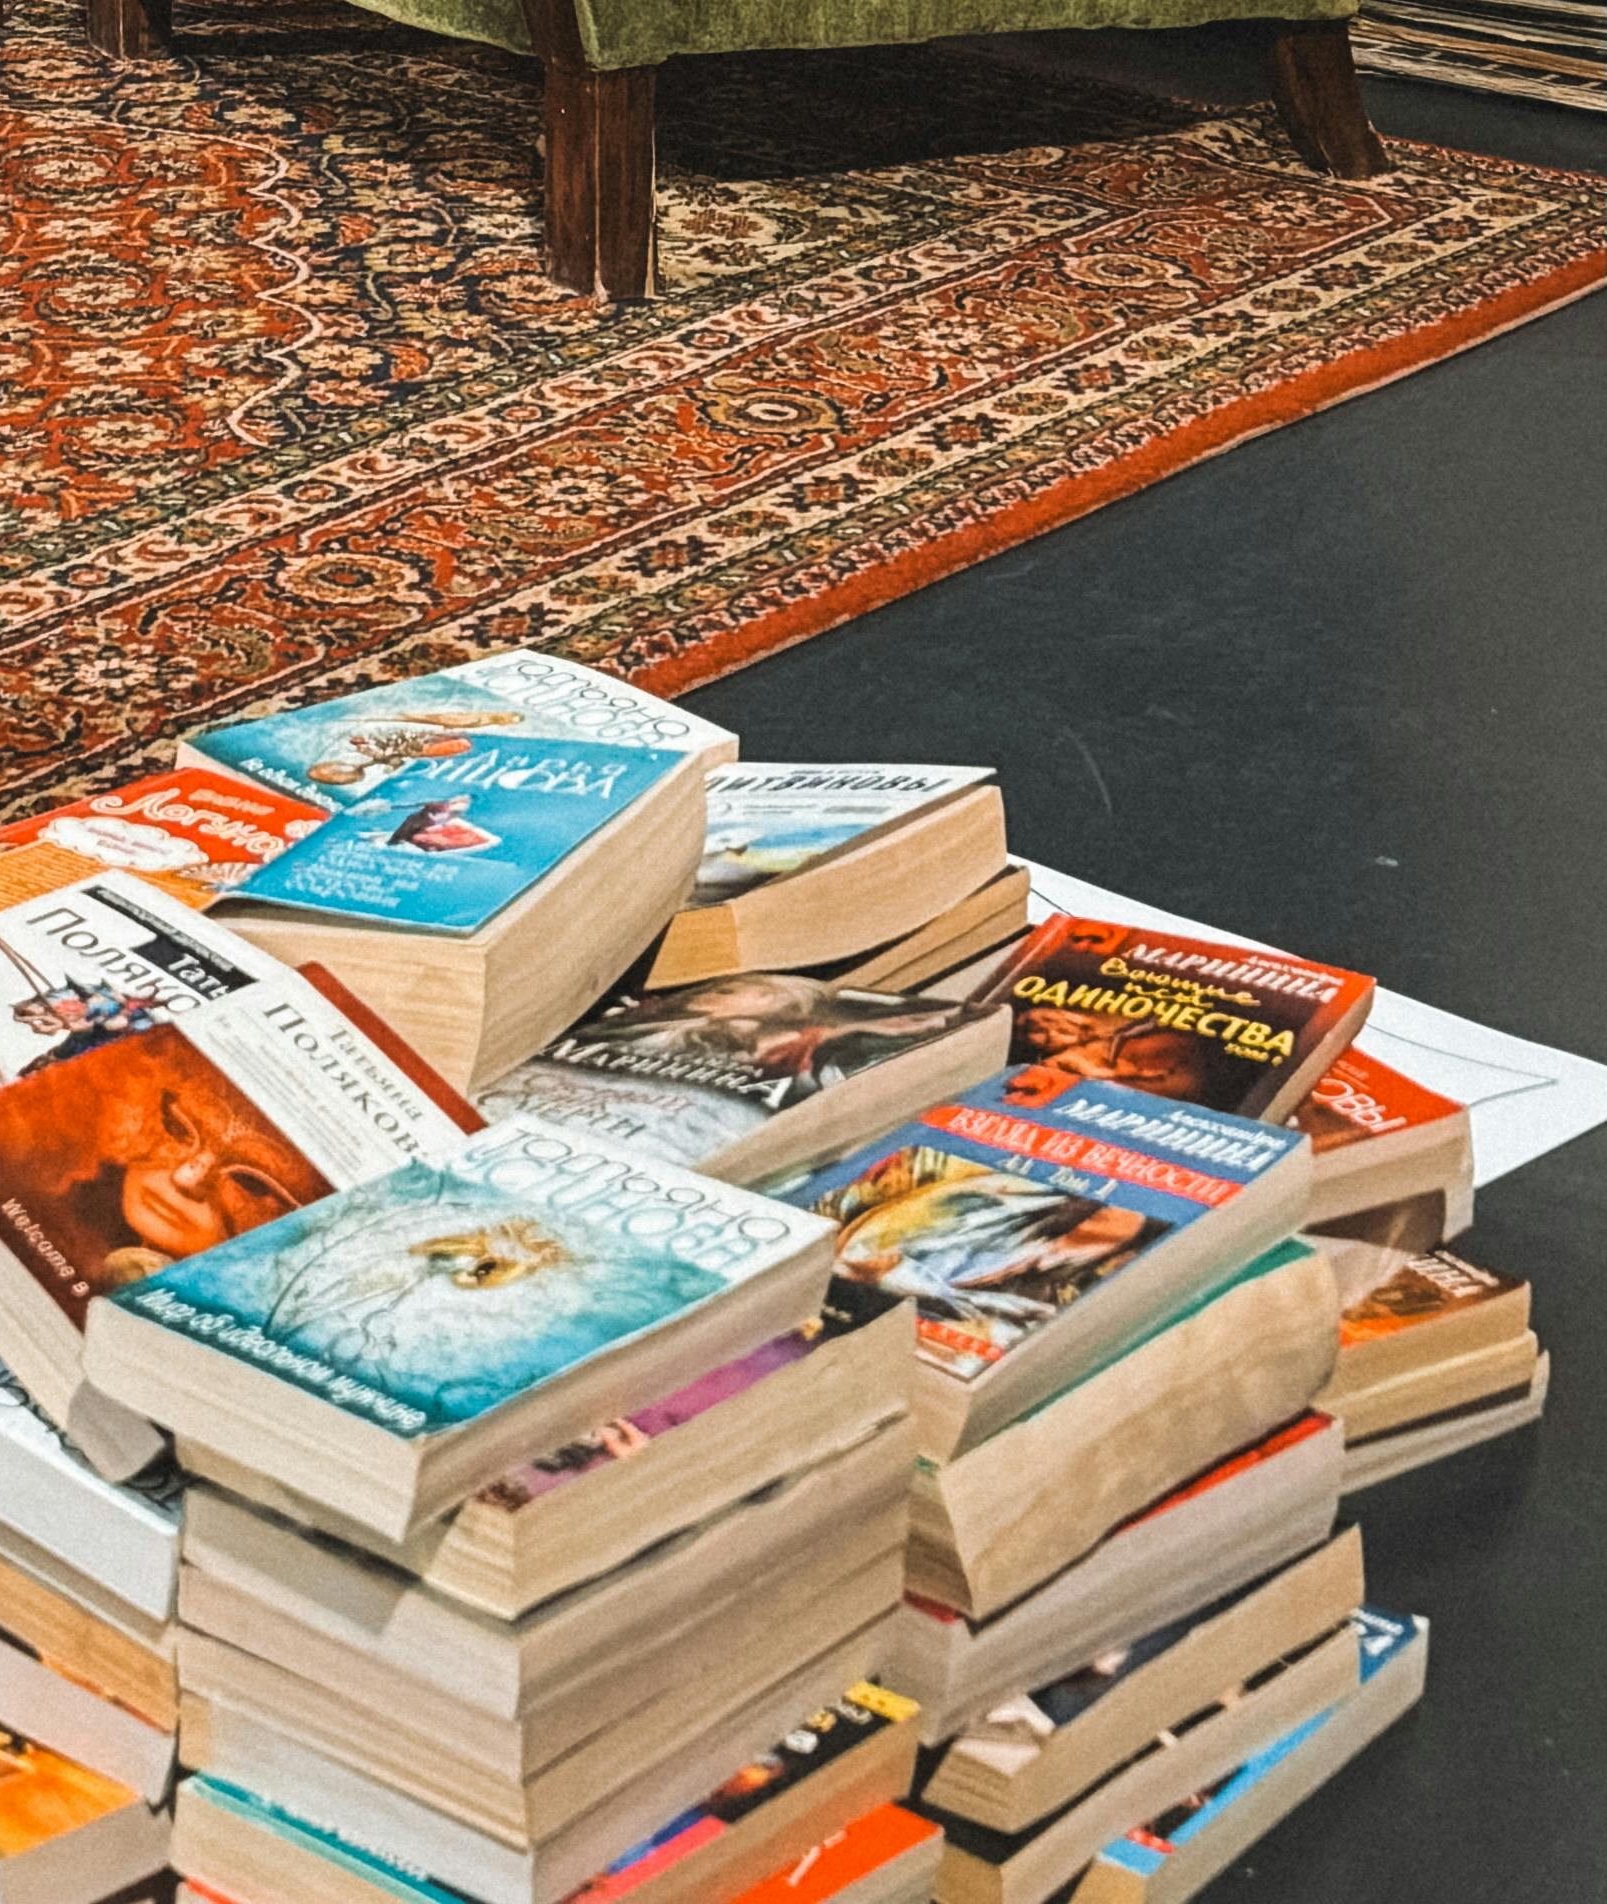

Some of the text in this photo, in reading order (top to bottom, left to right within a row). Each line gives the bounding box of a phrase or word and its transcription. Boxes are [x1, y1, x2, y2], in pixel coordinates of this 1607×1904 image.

[1012, 975, 1295, 1057] ОДИНОЧЕСТВА
[265, 1002, 431, 1160] ПОЛЯКОВ
[0, 1196, 73, 1277] Welcome
